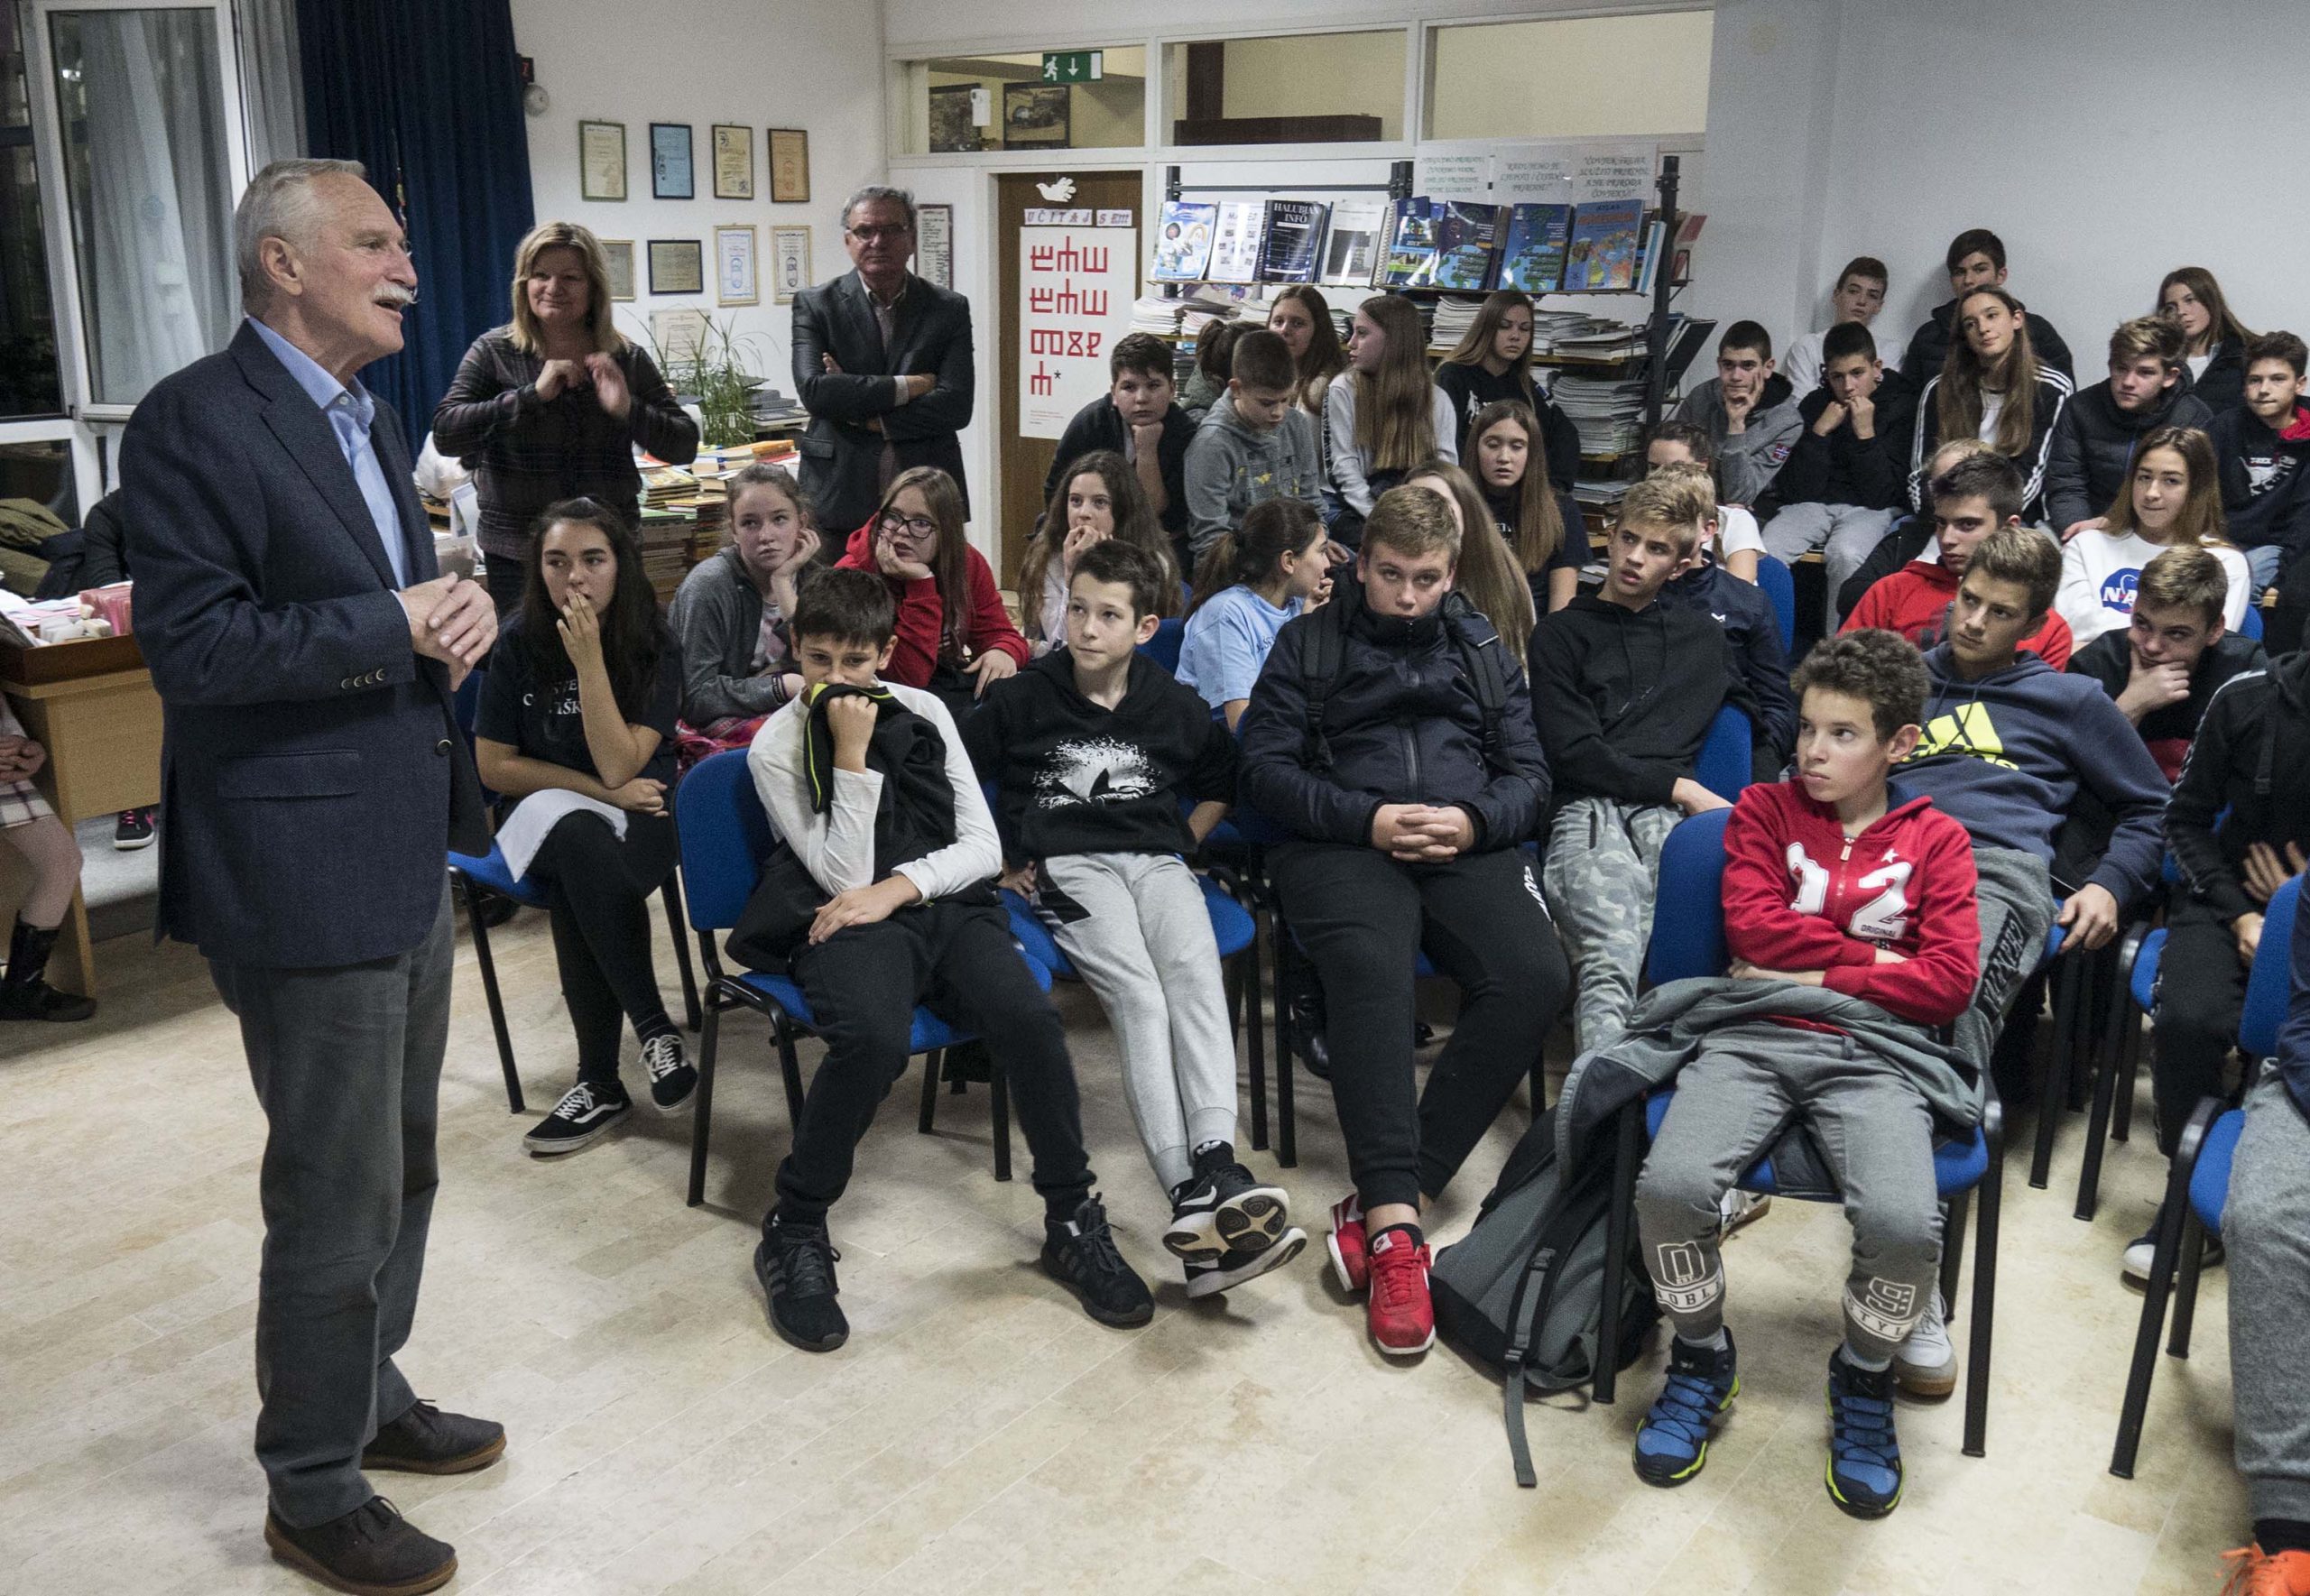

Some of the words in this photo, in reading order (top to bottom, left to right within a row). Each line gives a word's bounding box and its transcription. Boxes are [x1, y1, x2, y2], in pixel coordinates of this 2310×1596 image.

[1285, 213, 1308, 223] INFO
[2102, 586, 2138, 605] NA
[1860, 924, 1897, 938] ORIGINAL
[1846, 1296, 1906, 1337] TYL
